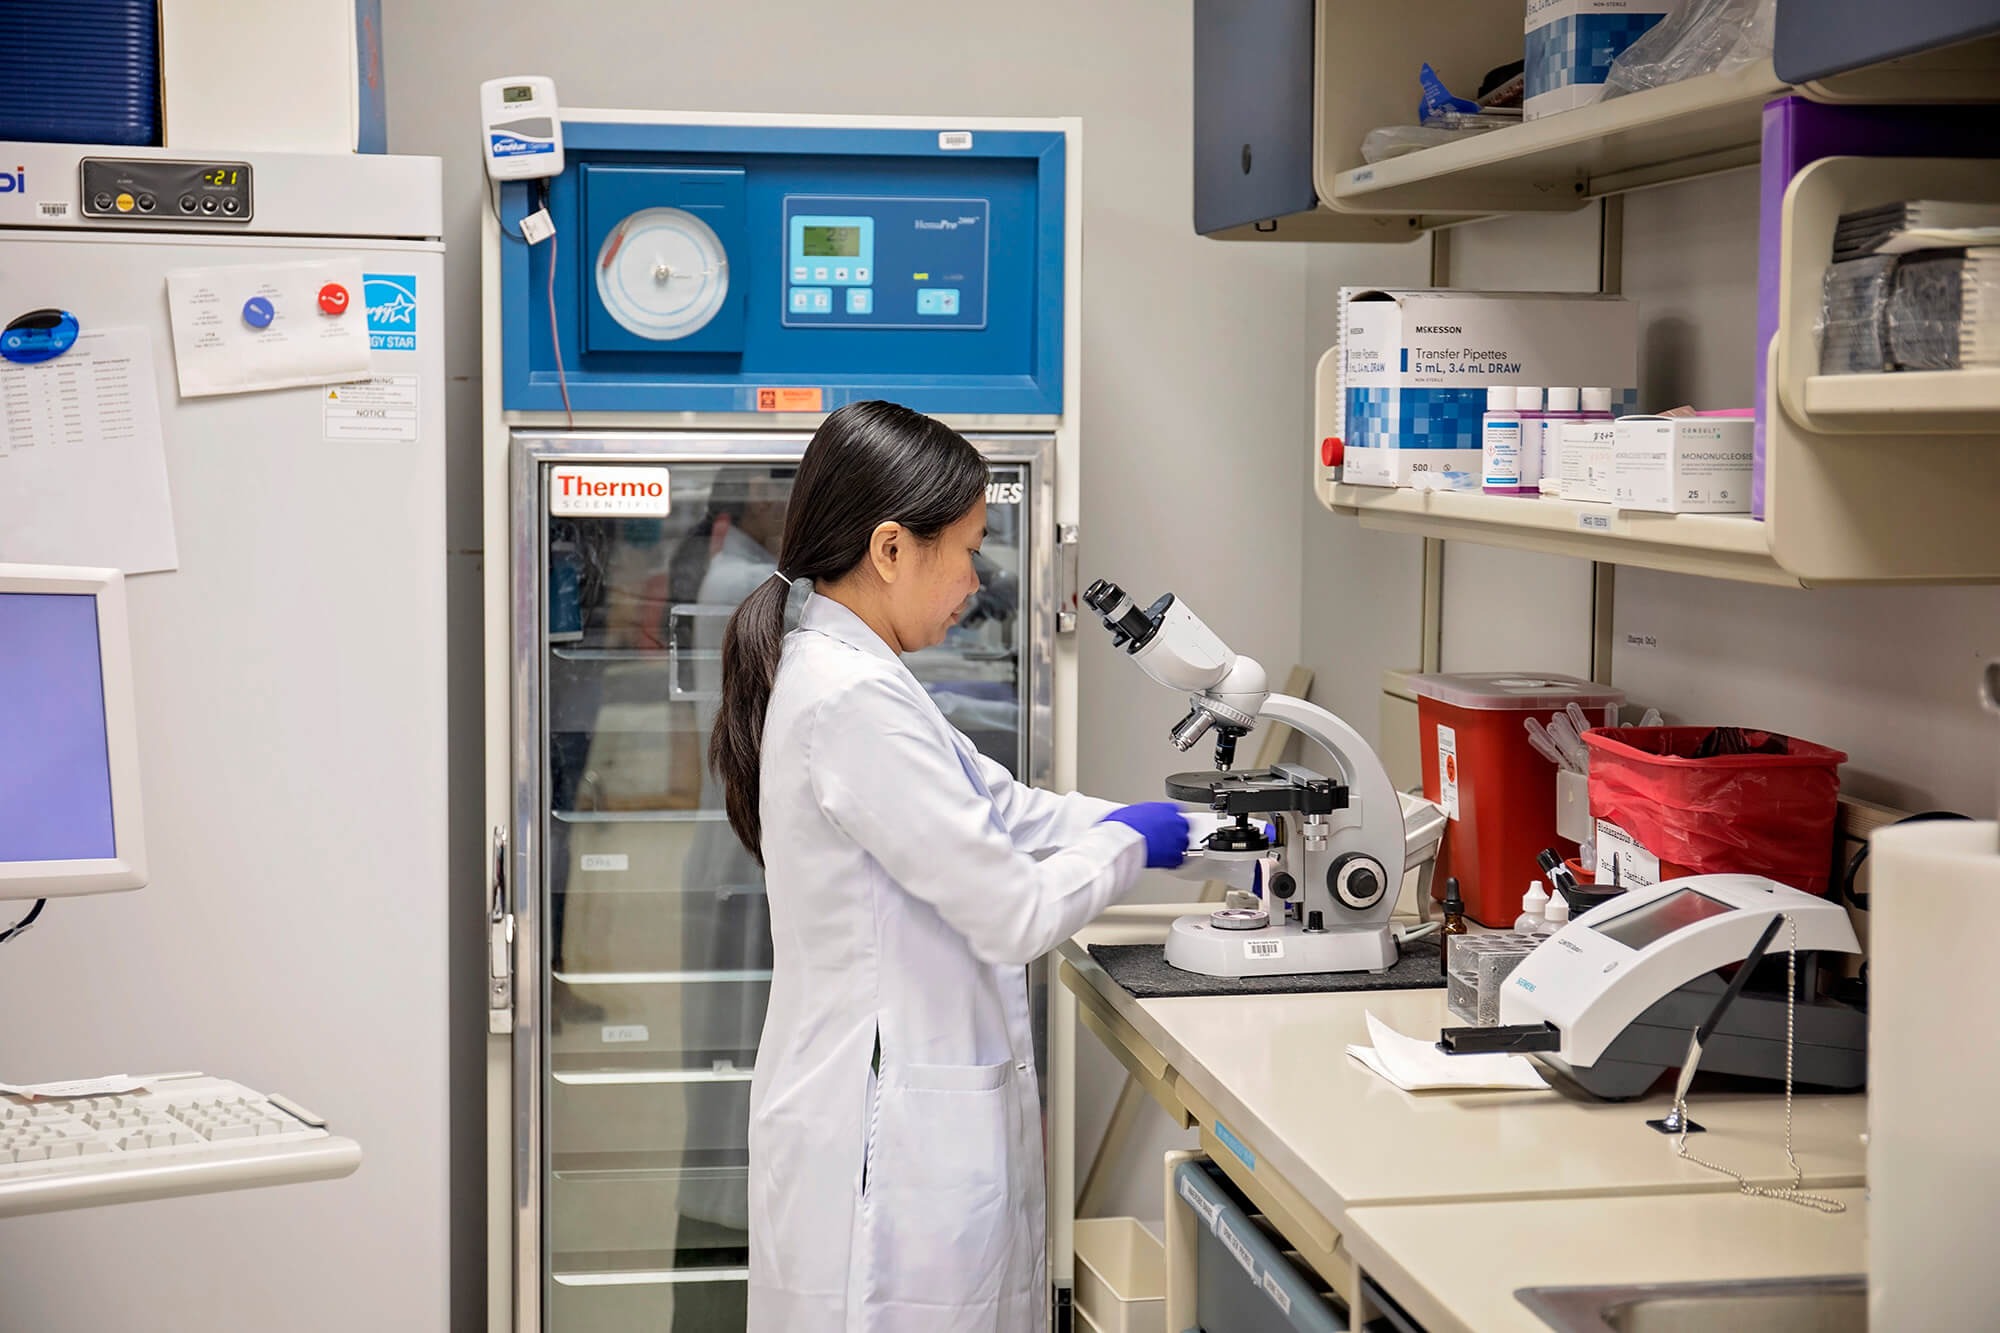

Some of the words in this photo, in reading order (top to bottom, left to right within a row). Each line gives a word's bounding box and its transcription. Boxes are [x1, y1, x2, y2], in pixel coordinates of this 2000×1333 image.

[204, 170, 237, 185] -21
[387, 336, 414, 348] STAR
[1416, 348, 1460, 359] Transfer
[1463, 348, 1508, 361] Pipettes
[1416, 363, 1422, 373] 5
[1425, 363, 1446, 374] mL,
[1449, 363, 1465, 373] 3.4
[1468, 363, 1485, 373] mL
[1488, 363, 1521, 374] DRAW
[356, 409, 386, 417] NOTICE
[1413, 463, 1429, 472] 500
[557, 475, 663, 497] Thermo
[1688, 490, 1700, 499] 25
[562, 500, 660, 509] SCIENTIFIC
